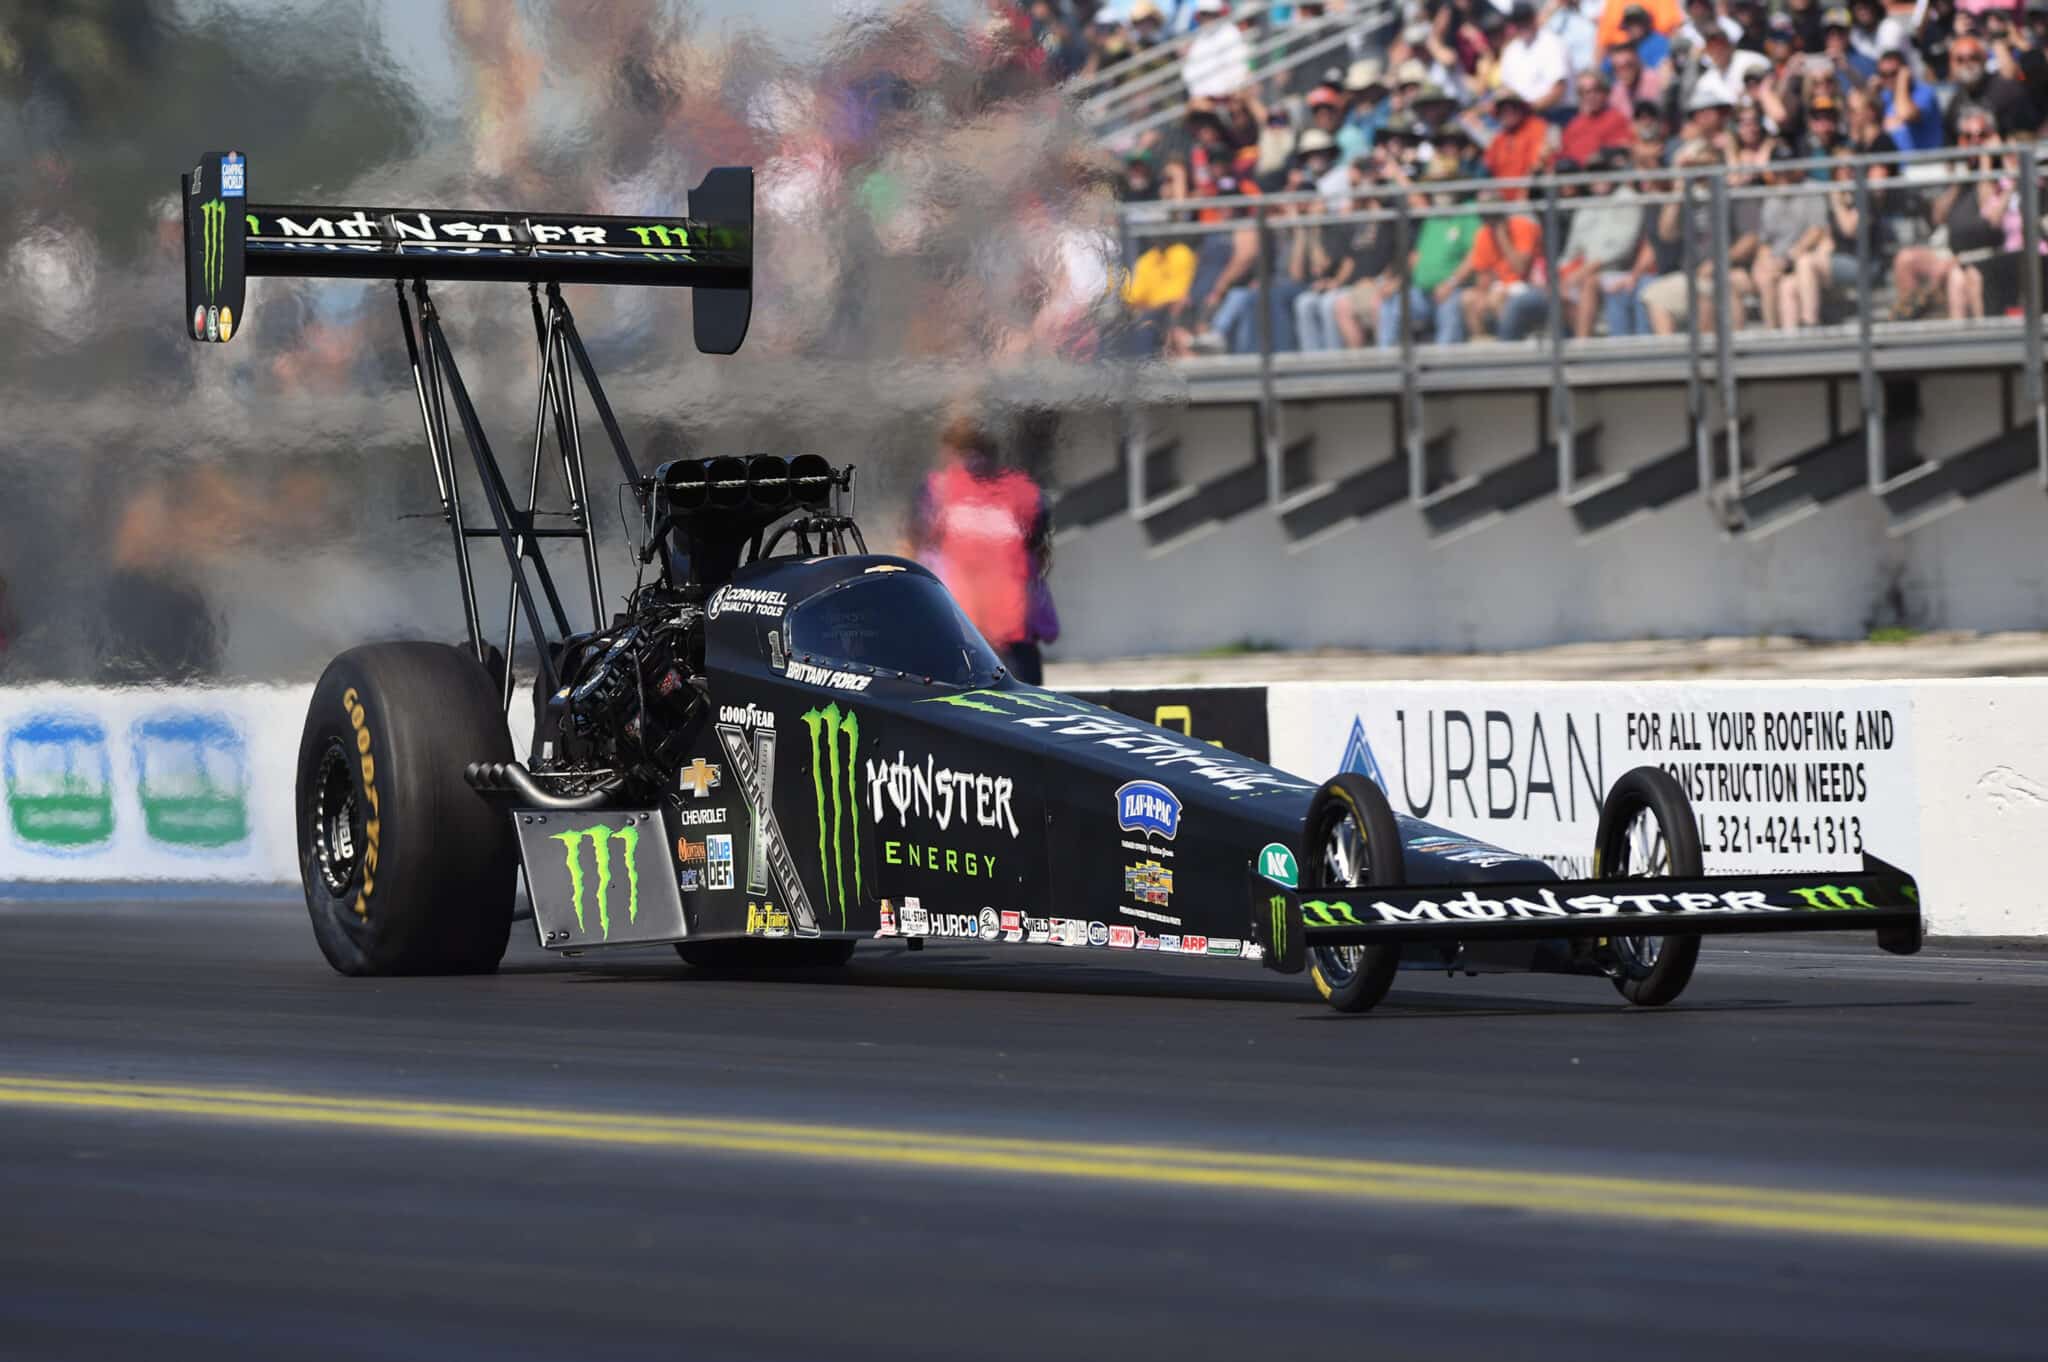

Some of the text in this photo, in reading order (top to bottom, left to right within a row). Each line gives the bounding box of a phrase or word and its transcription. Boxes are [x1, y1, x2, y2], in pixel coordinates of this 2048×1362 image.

[222, 164, 244, 175] CAMPING
[222, 175, 244, 190] WORLD
[277, 211, 608, 248] MONSTER
[720, 601, 784, 617] QUALITY TOOLS
[726, 588, 787, 606] CORNWELL
[785, 660, 873, 691] BRITTANY FORCE
[720, 703, 775, 730] GOODYEAR
[1626, 710, 1894, 751] FOR ALL YOUR ROOFING AND
[1396, 709, 1604, 822] URBAN
[865, 750, 1020, 839] MONSTER
[1659, 762, 1867, 802] NSTRUCTION NEEDS
[681, 808, 727, 826] CHEVROLET
[1124, 794, 1173, 827] FLAV-R-PAC
[708, 838, 731, 860] Blue
[1718, 815, 1863, 854] 321-424-1313
[709, 860, 733, 887] DEF
[764, 820, 806, 920] FORCE
[885, 840, 998, 880] ENERGY
[1371, 888, 1792, 923] MONSTER
[930, 913, 978, 937] HURCO
[1027, 919, 1049, 932] WELD
[1183, 936, 1206, 950] ARP
